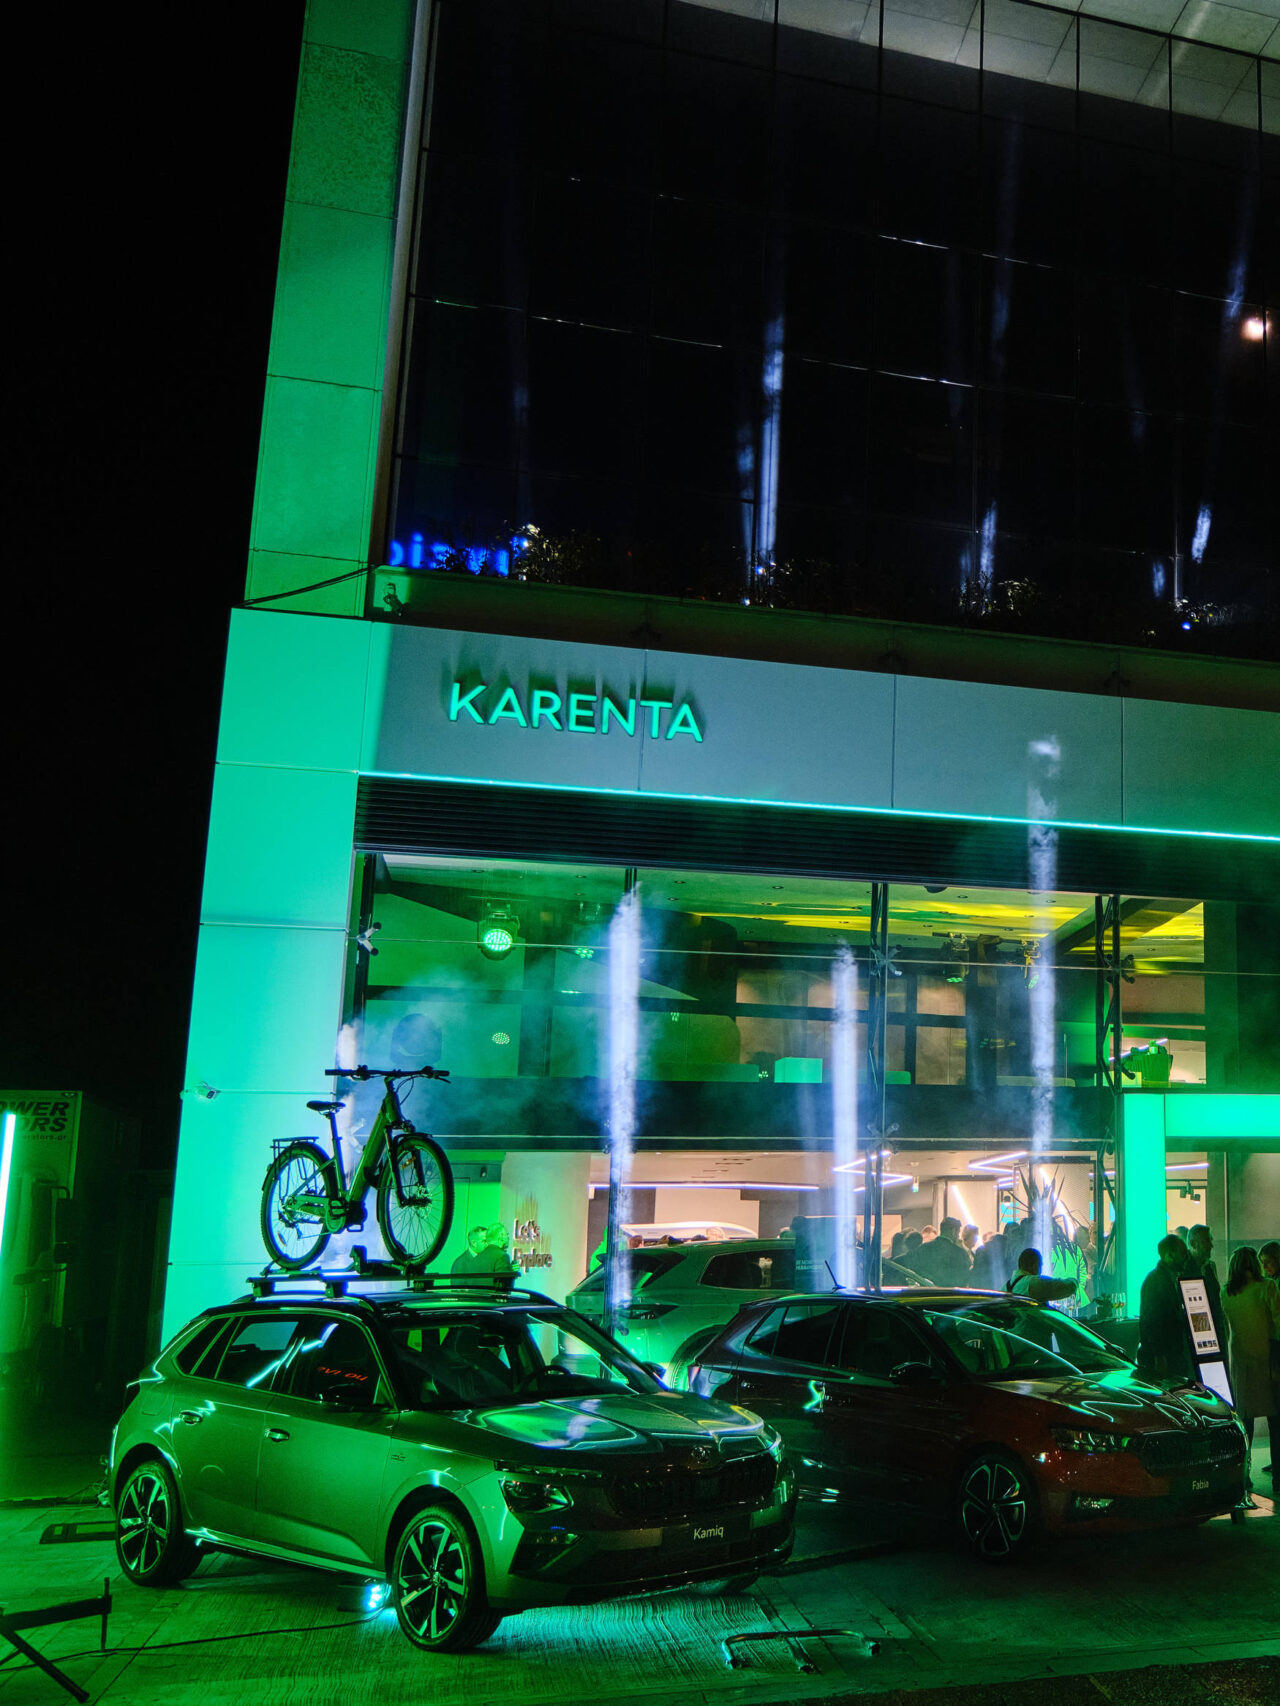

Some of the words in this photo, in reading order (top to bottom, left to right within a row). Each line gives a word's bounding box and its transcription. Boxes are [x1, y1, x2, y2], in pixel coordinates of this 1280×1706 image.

[448, 681, 704, 744] KARENTA
[1191, 1479, 1210, 1491] Fabia
[693, 1525, 725, 1542] Kamiq
